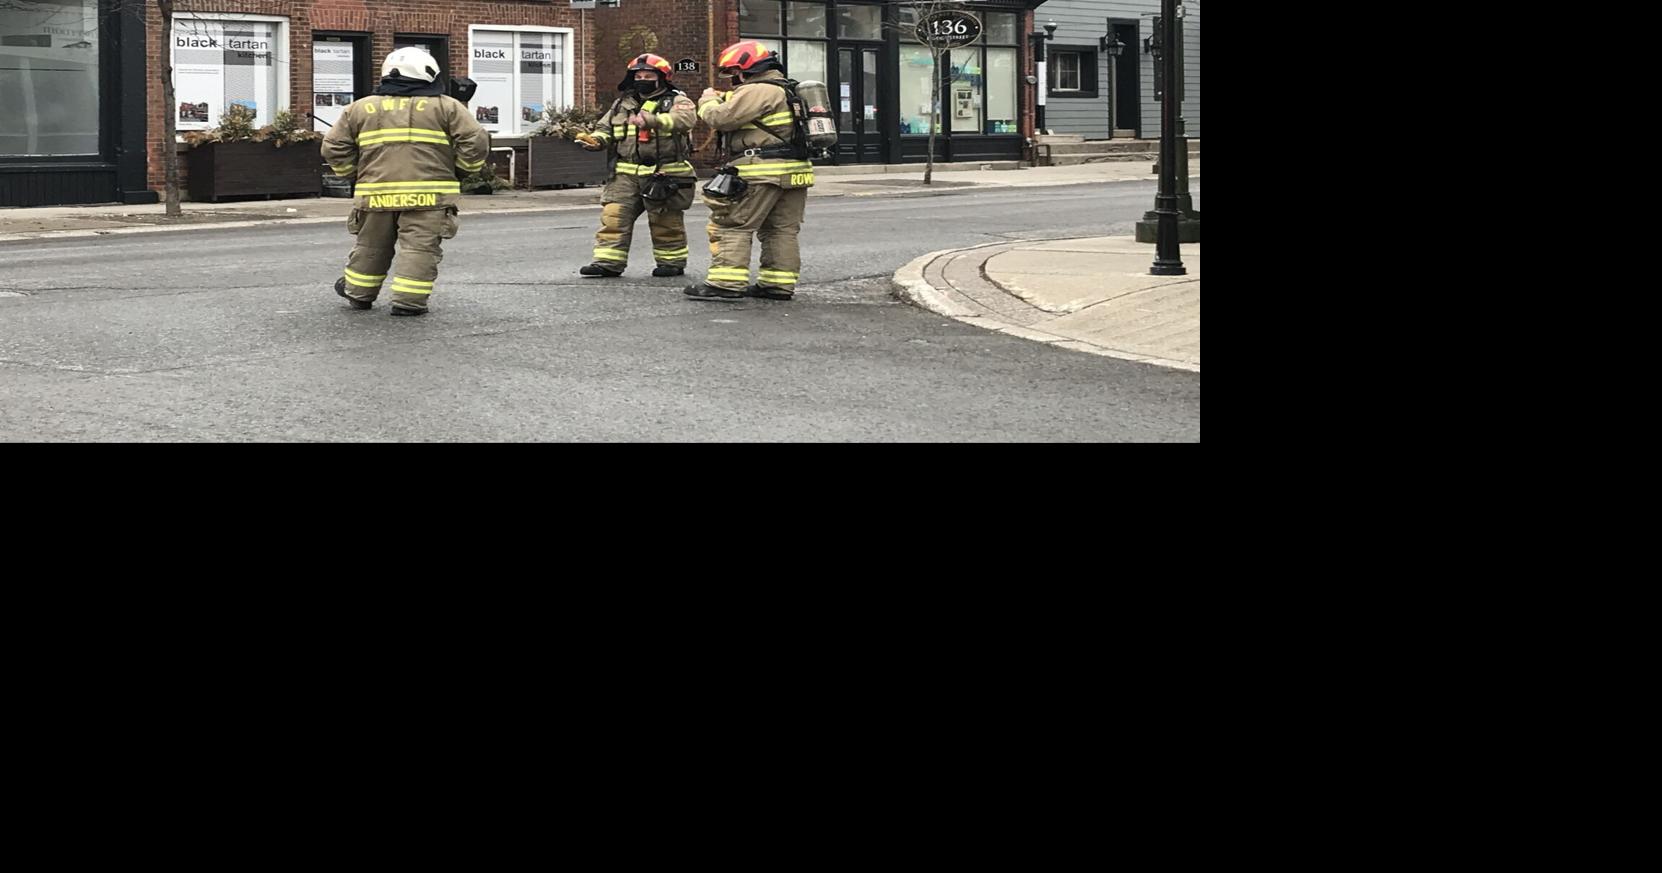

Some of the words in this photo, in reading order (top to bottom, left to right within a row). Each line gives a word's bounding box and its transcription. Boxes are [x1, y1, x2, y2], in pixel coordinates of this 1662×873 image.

[932, 19, 967, 35] 136
[176, 37, 218, 48] black
[228, 39, 268, 50] tartan
[474, 49, 506, 59] black
[521, 50, 551, 60] tartan
[678, 62, 695, 71] 138
[369, 193, 437, 209] ANDERSON
